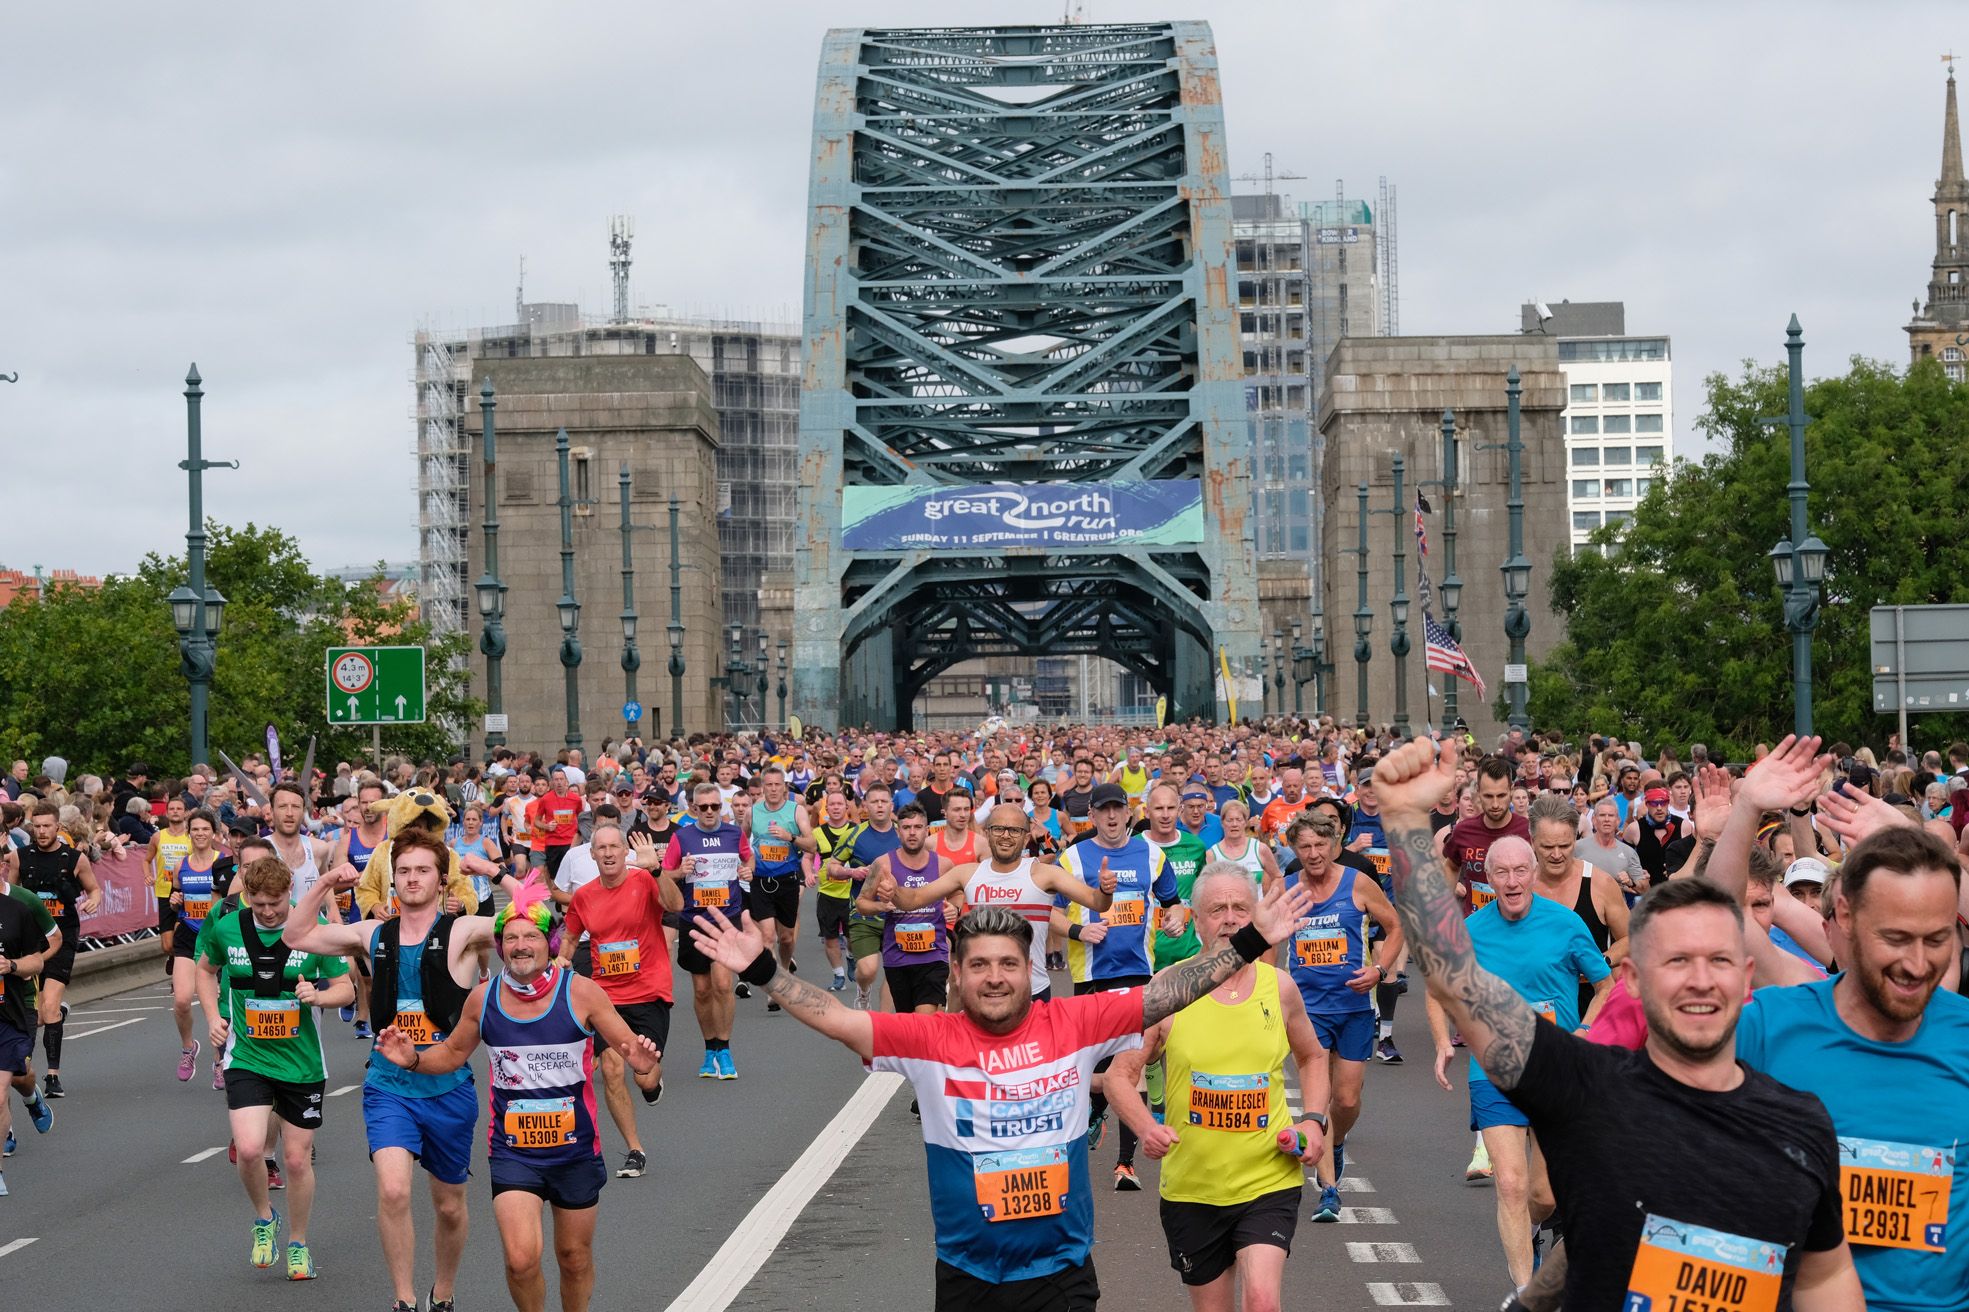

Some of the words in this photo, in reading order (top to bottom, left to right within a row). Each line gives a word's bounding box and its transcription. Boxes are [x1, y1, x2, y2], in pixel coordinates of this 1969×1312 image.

[924, 498, 1000, 520] great
[1030, 492, 1110, 516] north
[1067, 514, 1116, 530] run
[901, 533, 948, 543] SUNDAY
[953, 535, 967, 544] 11
[1053, 529, 1144, 542] GREATRUN.ORG
[702, 837, 721, 847] DAN
[1466, 848, 1485, 860] RE
[1466, 861, 1483, 872] AC
[702, 889, 721, 898] DANIEL
[975, 884, 1023, 902] Abbey
[192, 910, 208, 918] 1078
[1114, 903, 1133, 913] MIKE
[1112, 914, 1136, 924] 13091
[906, 932, 923, 941] SEAN
[1303, 940, 1339, 953] WILLIAM
[229, 957, 252, 966] CANC
[608, 952, 626, 963] JOHN
[258, 1012, 285, 1024] OWEN
[397, 1014, 423, 1028] RORY
[257, 1025, 286, 1036] 14650
[526, 1051, 569, 1062] CANCER
[528, 1060, 578, 1072] RESEARCH
[529, 1072, 543, 1081] UK
[992, 1068, 1079, 1100] TEENAGE
[991, 1090, 1075, 1118] CANCER
[1192, 1090, 1233, 1110] GRAHAME
[1236, 1091, 1266, 1109] LESLEY
[518, 1114, 562, 1129] NEVILLE
[992, 1113, 1061, 1137] TRUST
[1208, 1111, 1250, 1128] 11584
[523, 1130, 558, 1145] 15309
[1001, 1170, 1048, 1194] JAMIE
[1848, 1173, 1916, 1208] DANIEL
[1002, 1192, 1051, 1216] 13298
[1848, 1207, 1911, 1242] 12931
[1676, 1261, 1747, 1305] DAVID
